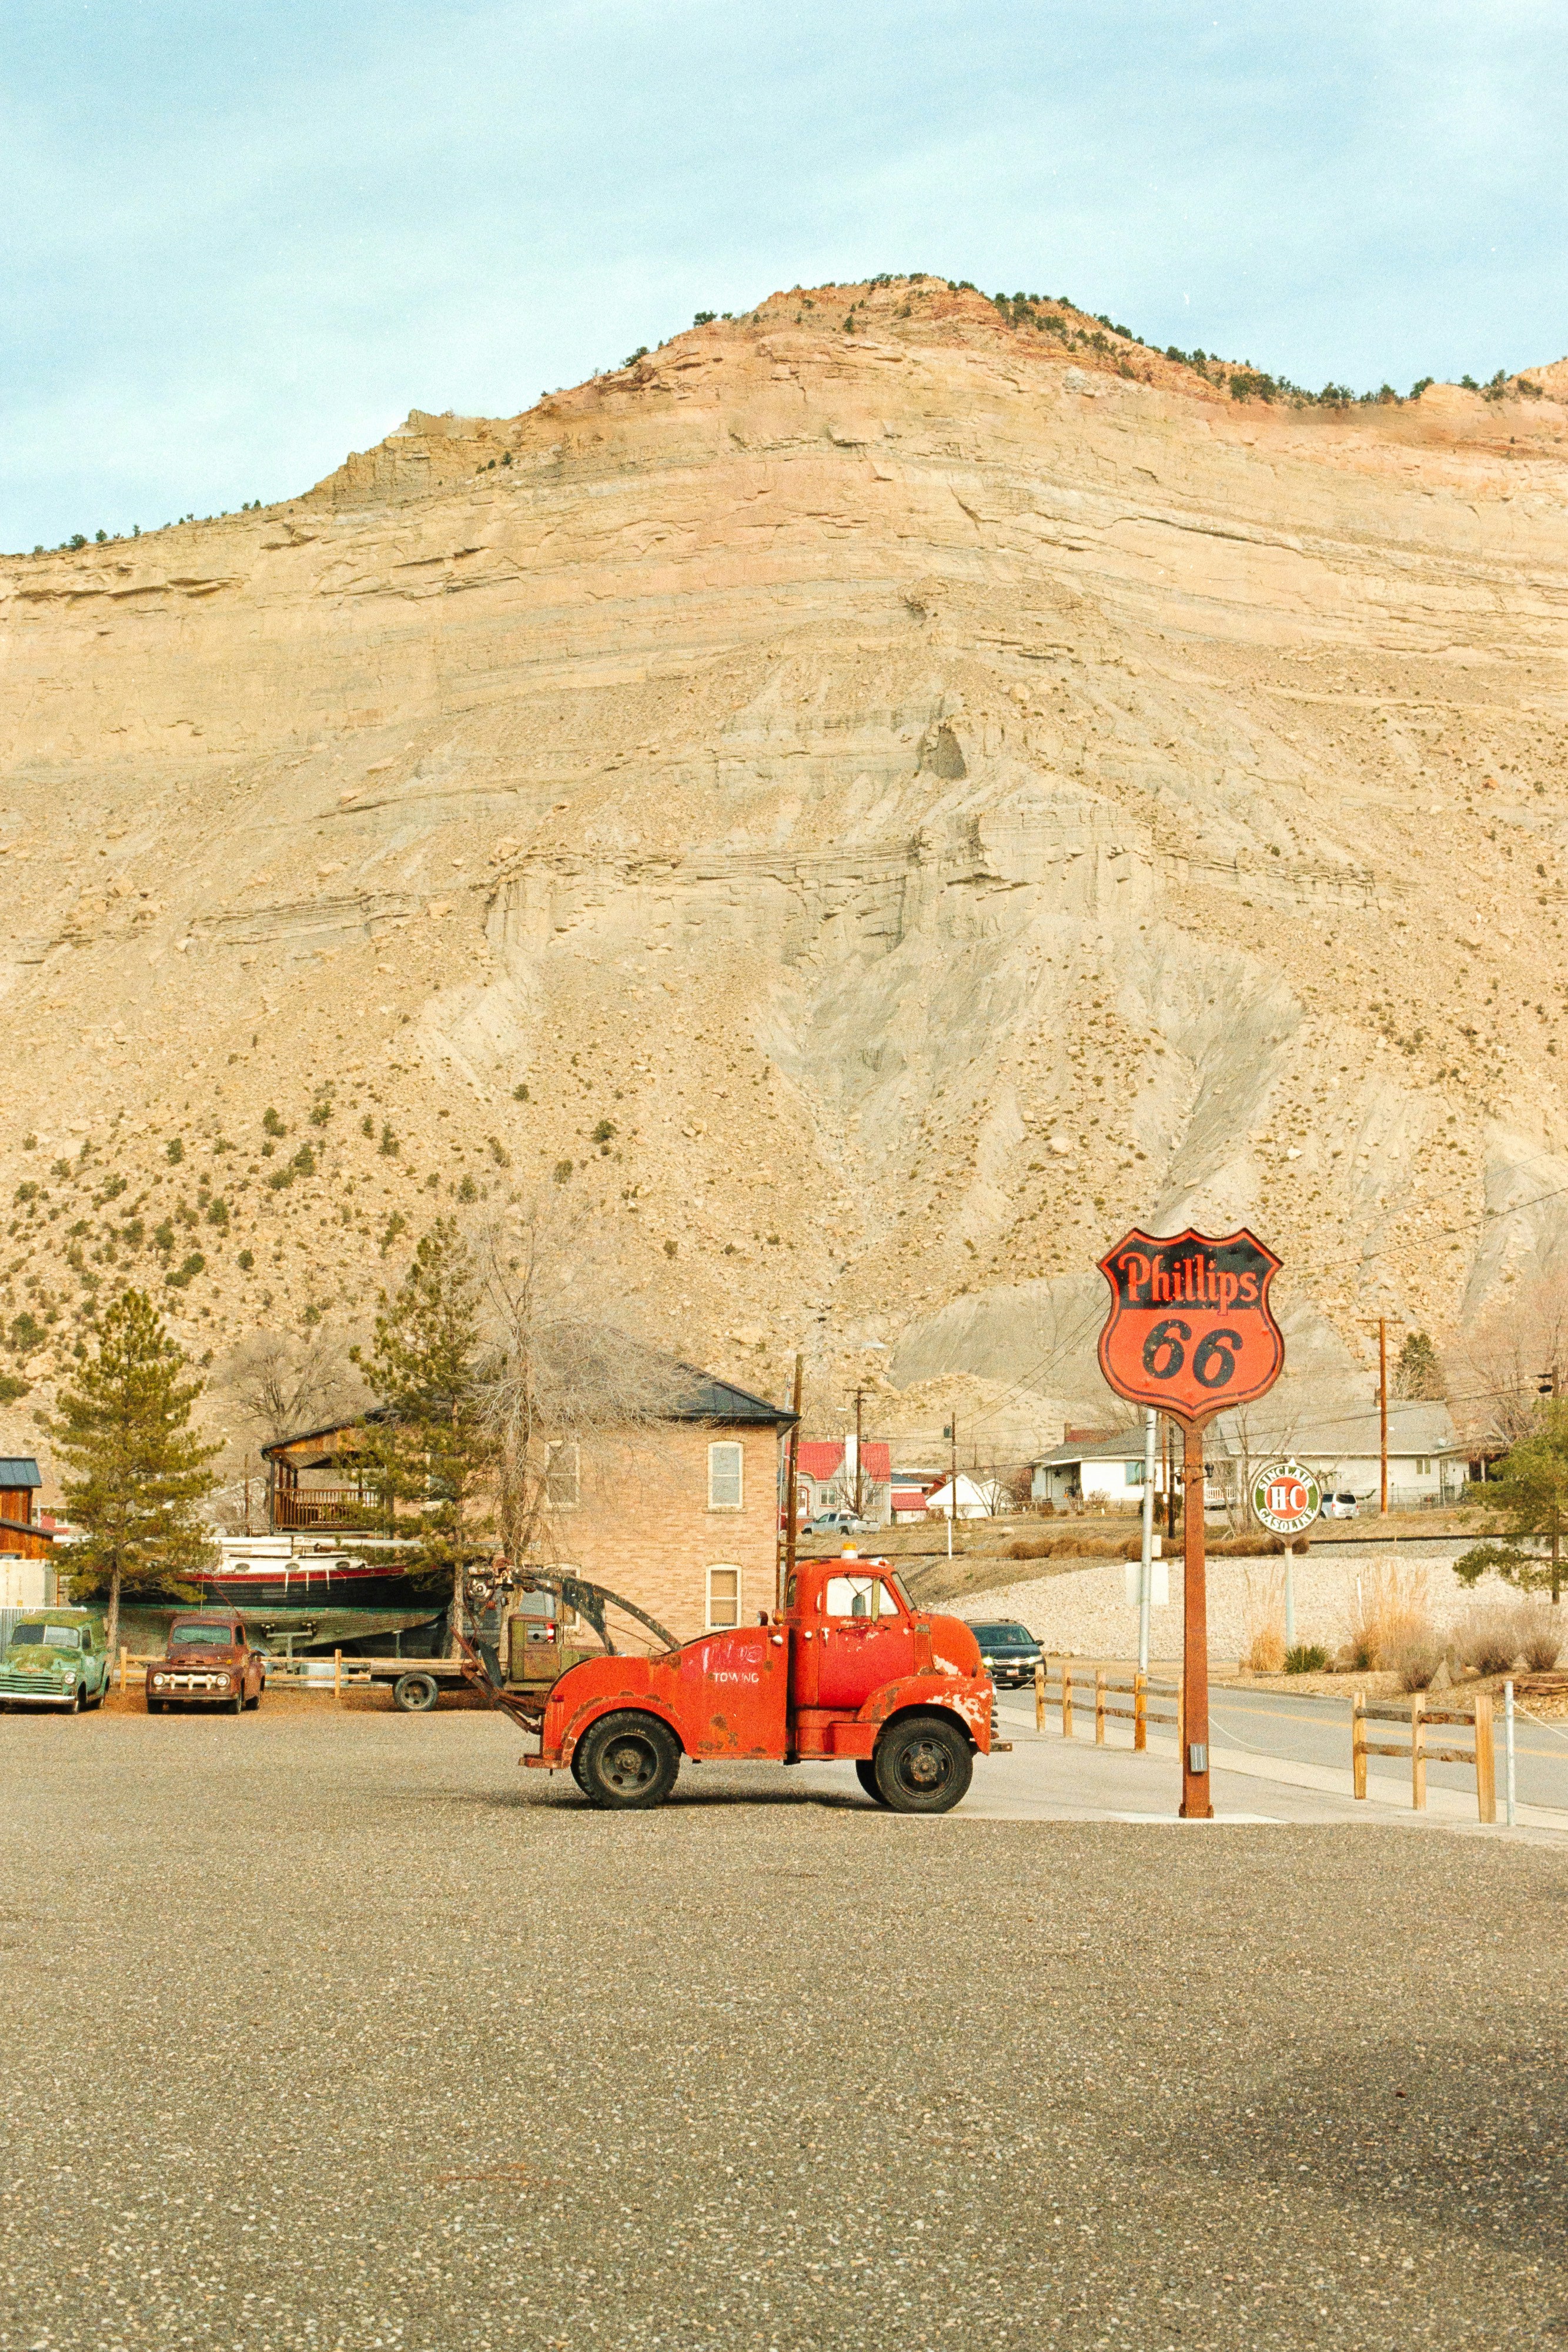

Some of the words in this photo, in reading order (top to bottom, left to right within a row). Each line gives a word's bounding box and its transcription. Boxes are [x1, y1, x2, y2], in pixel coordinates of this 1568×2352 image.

[1118, 1252, 1259, 1316] Phillips
[1142, 1319, 1243, 1388] 66
[1258, 1466, 1313, 1491] SINCLAIR
[1259, 1508, 1316, 1531] GASOLINE
